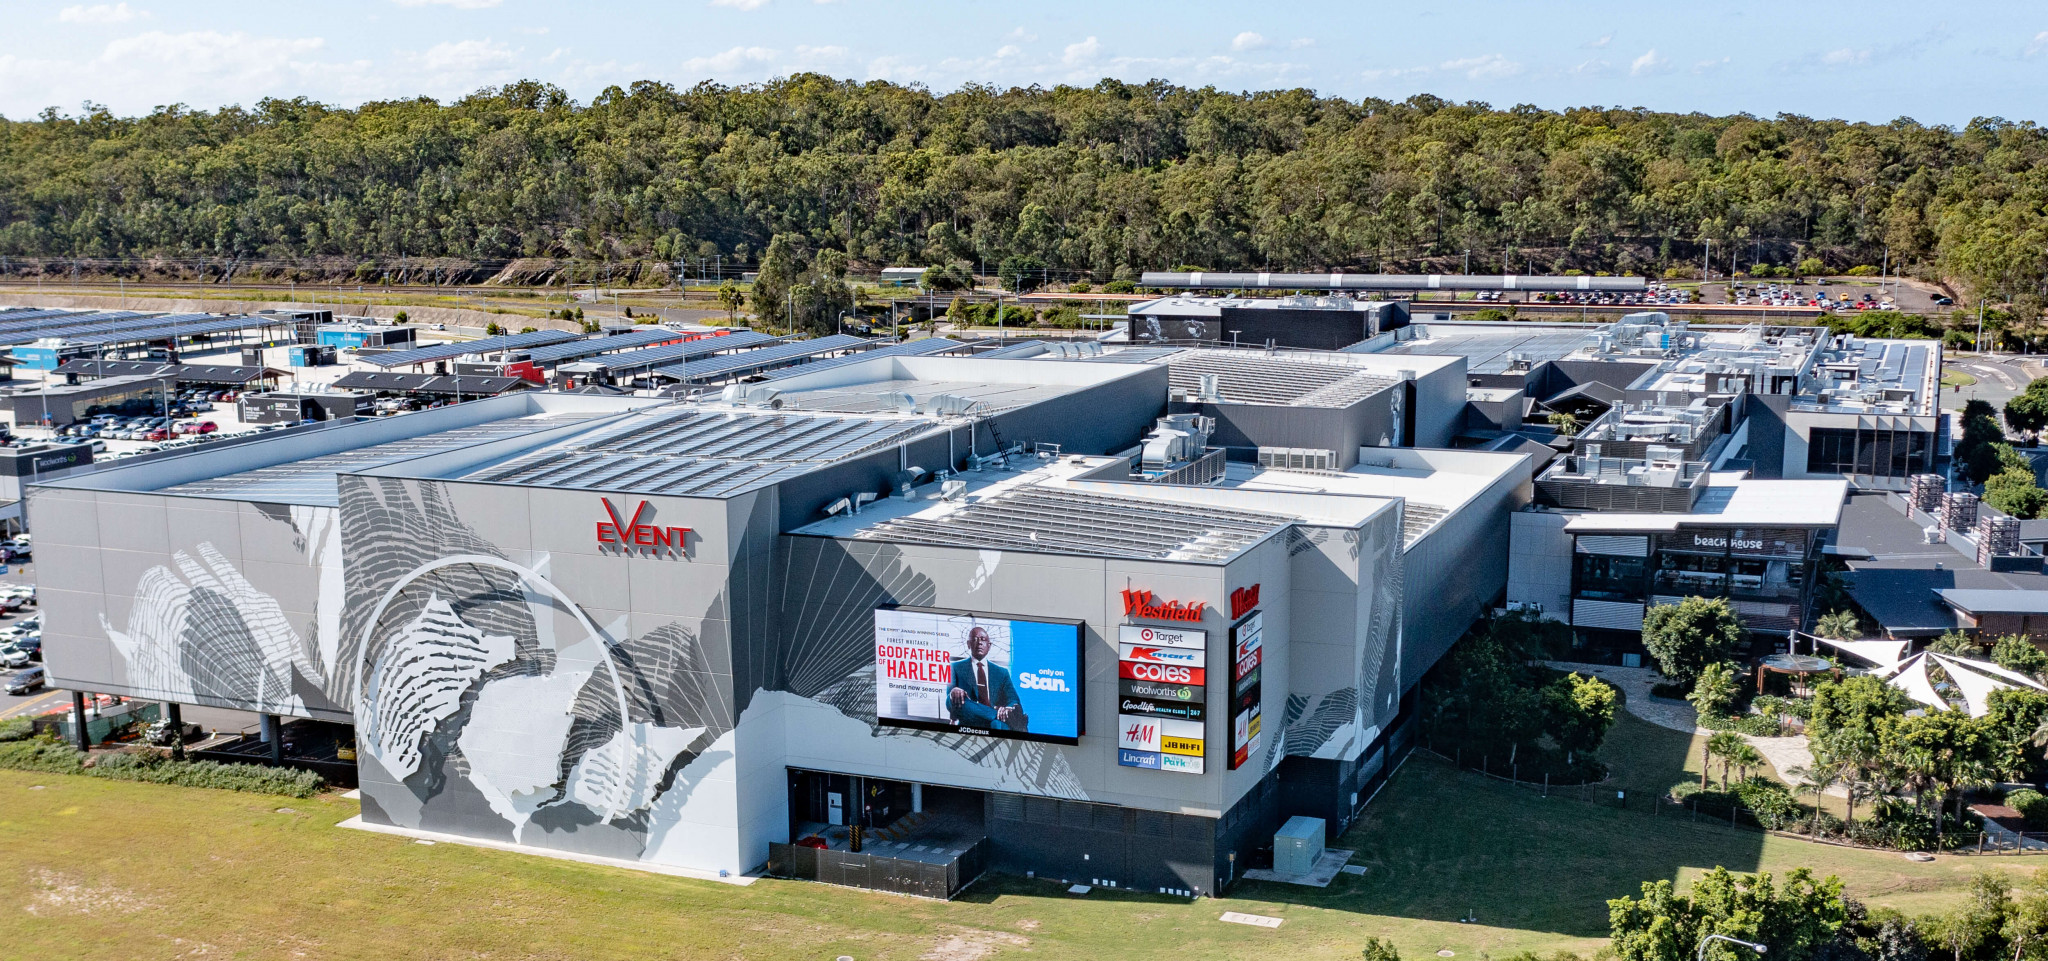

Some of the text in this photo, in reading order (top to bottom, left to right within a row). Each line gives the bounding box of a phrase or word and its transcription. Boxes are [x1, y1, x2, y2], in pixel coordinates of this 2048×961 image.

[597, 497, 692, 547] EVENT
[1694, 534, 1763, 549] beach house
[1119, 589, 1207, 623] Westfield
[1154, 631, 1183, 644] Target
[878, 644, 950, 664] GODFATHER
[1129, 646, 1195, 661] Kmart
[1239, 636, 1259, 659] Kmart
[1239, 650, 1258, 676] coles
[887, 659, 951, 683] HARLEM
[1038, 668, 1055, 677] only
[1133, 663, 1191, 683] coles
[888, 682, 907, 690] Brand
[1019, 672, 1070, 692] Stan.
[904, 690, 917, 698] April
[1131, 684, 1177, 697] Woolworths
[1122, 699, 1156, 713] Goodlife
[958, 726, 990, 735] JCDecaux
[1126, 723, 1154, 744] H&M
[1165, 741, 1178, 749] JB
[1123, 752, 1156, 765] Lincraft
